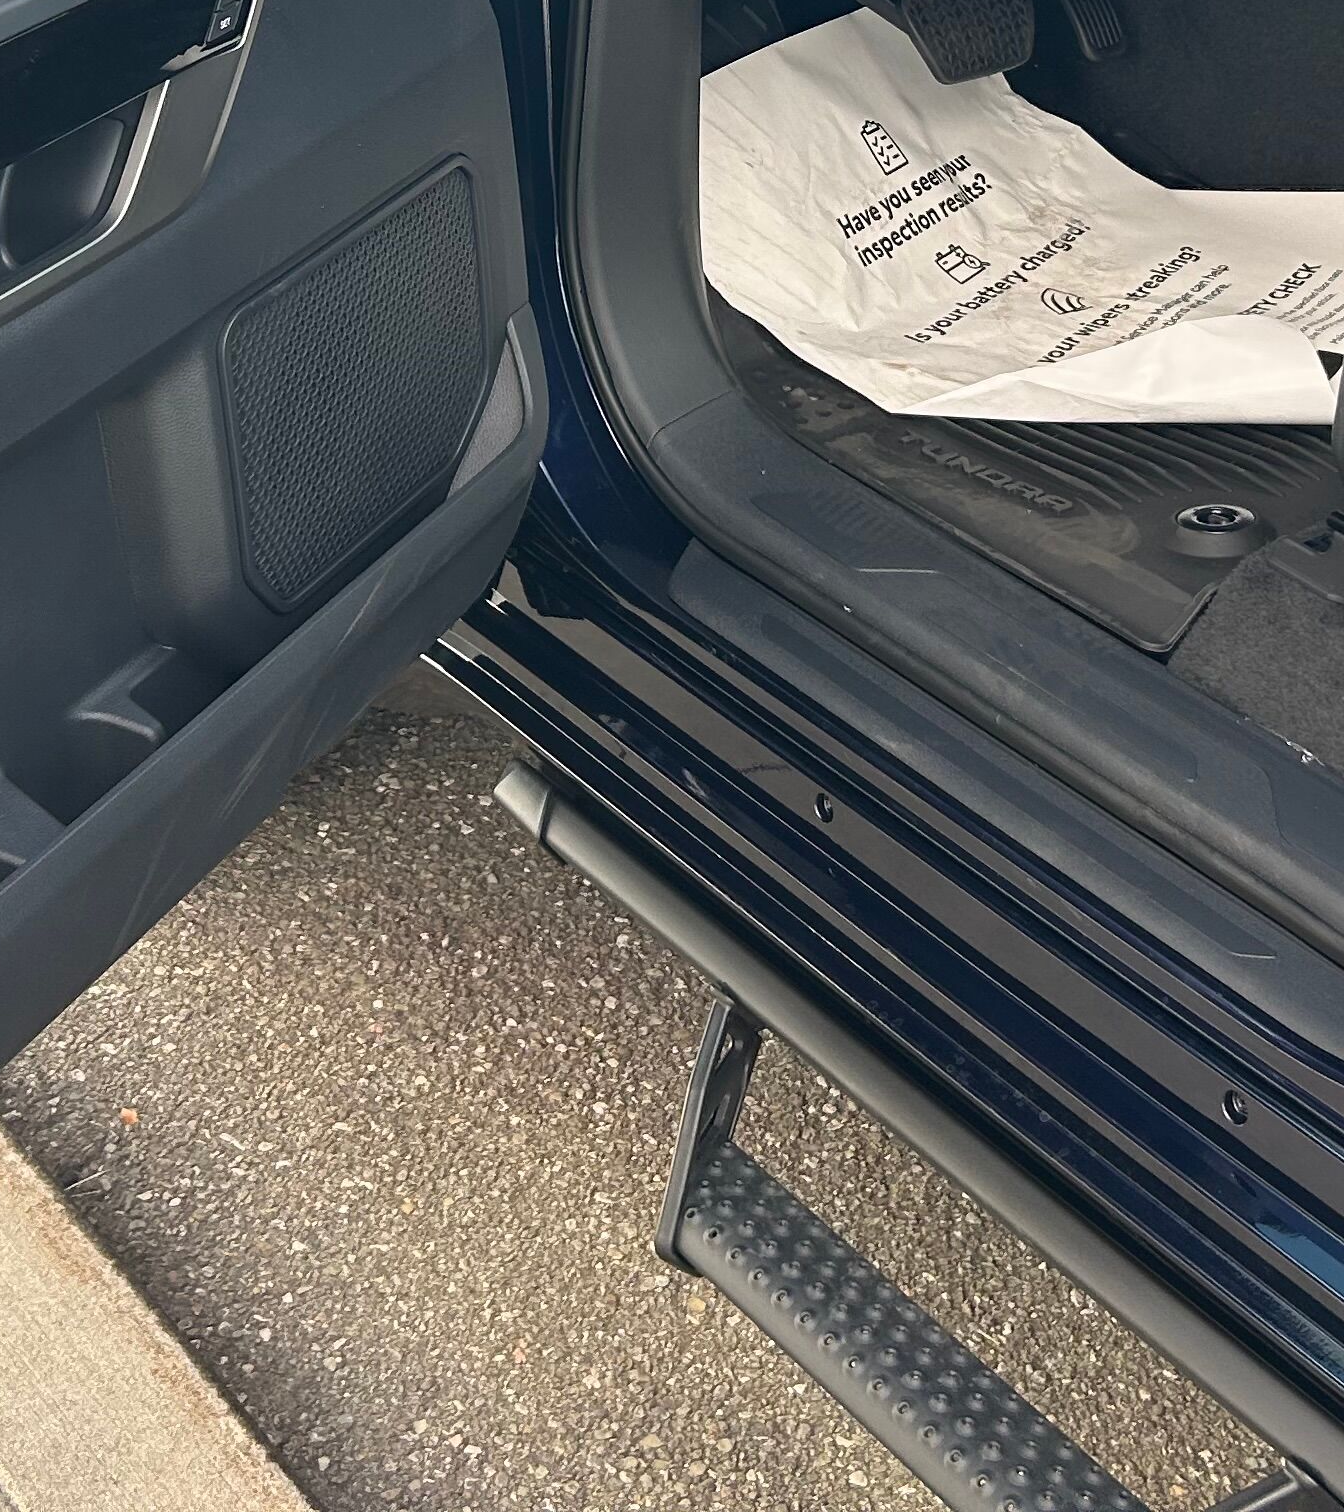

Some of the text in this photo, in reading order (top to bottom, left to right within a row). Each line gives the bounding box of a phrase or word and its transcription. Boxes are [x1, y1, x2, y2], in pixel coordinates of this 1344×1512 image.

[836, 154, 972, 239] Have you seen your
[854, 172, 993, 267] inspection results?
[904, 219, 1092, 343] Is your battery charged?
[1037, 246, 1202, 364] your wipers streaking?
[1160, 308, 1191, 329] tions
[1190, 280, 1211, 294] can
[1201, 264, 1230, 281] help
[1237, 263, 1323, 316] ETY CHECK
[899, 430, 1073, 513] TUNDRA
